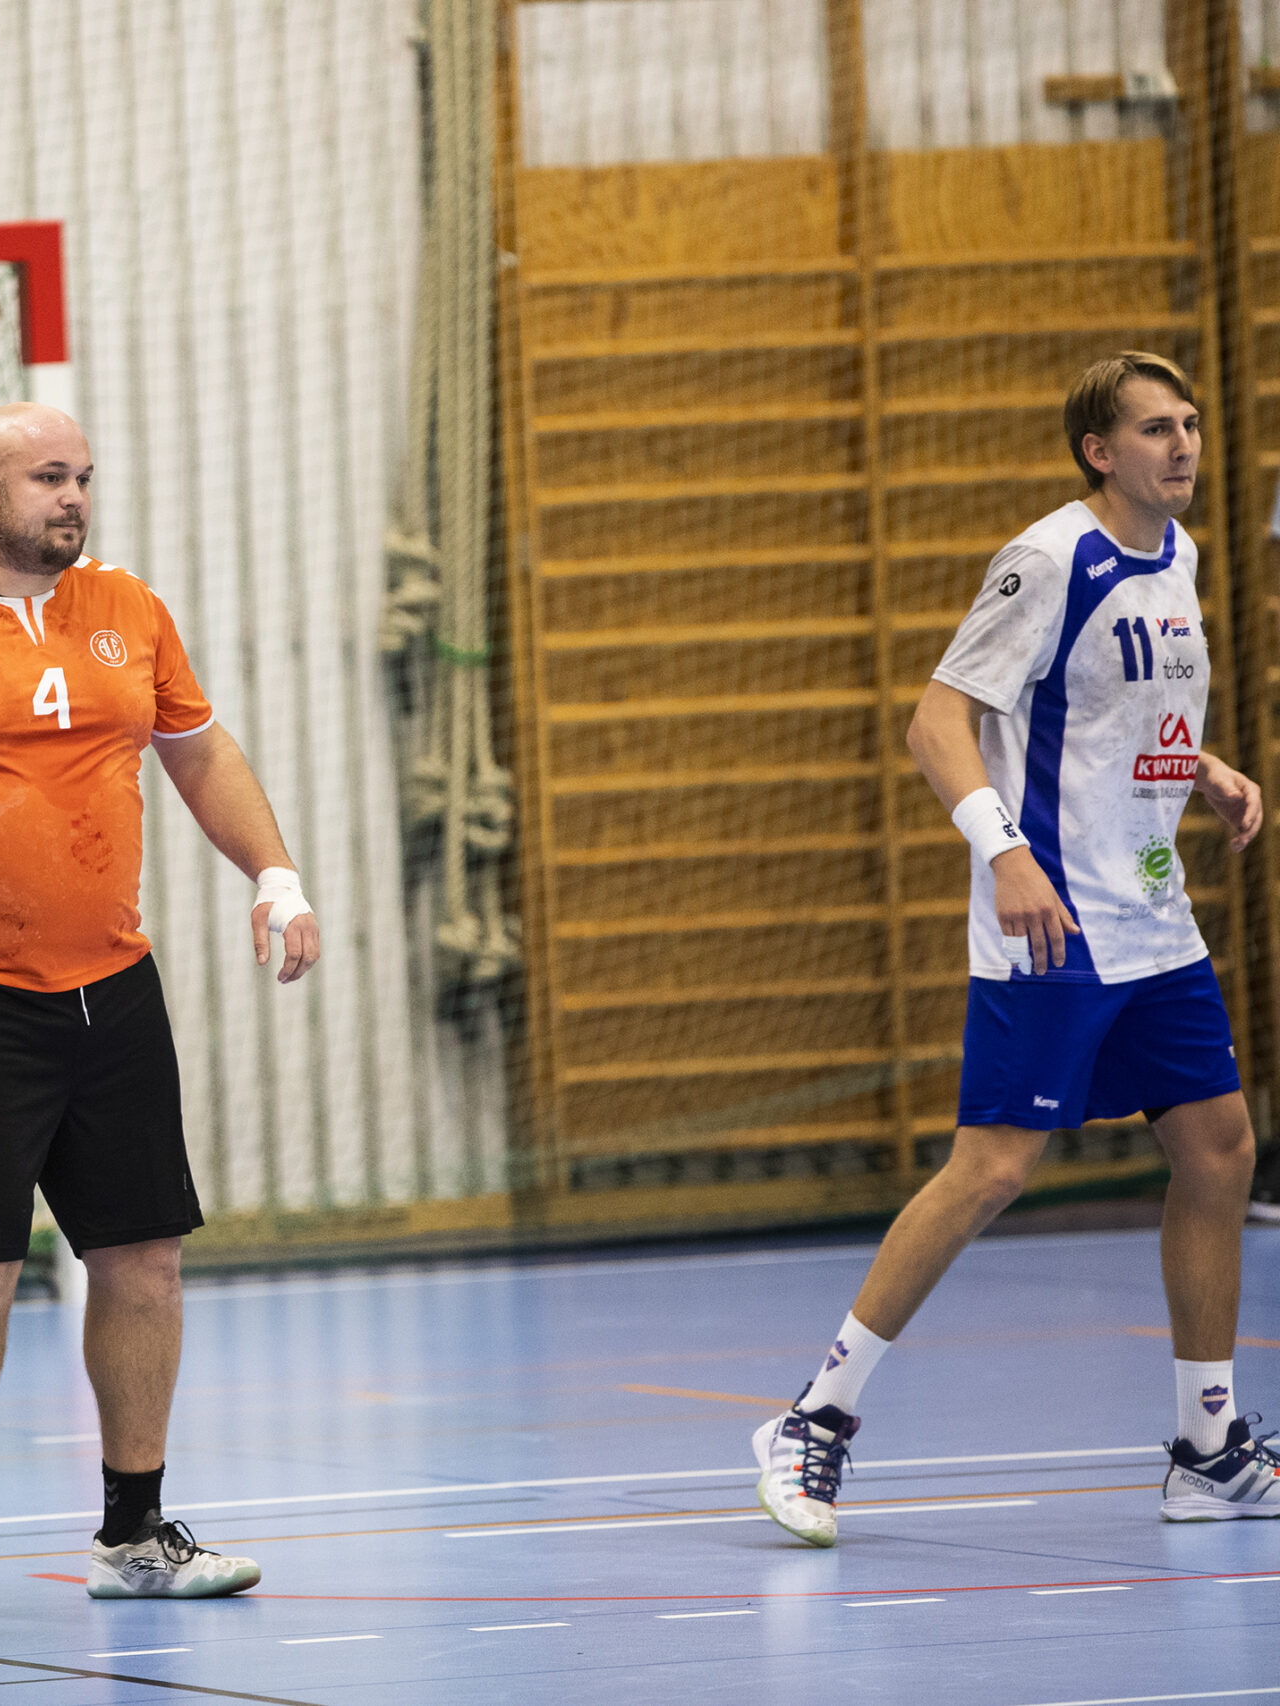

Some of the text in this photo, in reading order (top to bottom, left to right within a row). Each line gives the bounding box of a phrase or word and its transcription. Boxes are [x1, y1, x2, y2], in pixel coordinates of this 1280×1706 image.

[1086, 556, 1118, 580] Kempa
[1112, 616, 1153, 681] 11
[32, 667, 72, 729] 4
